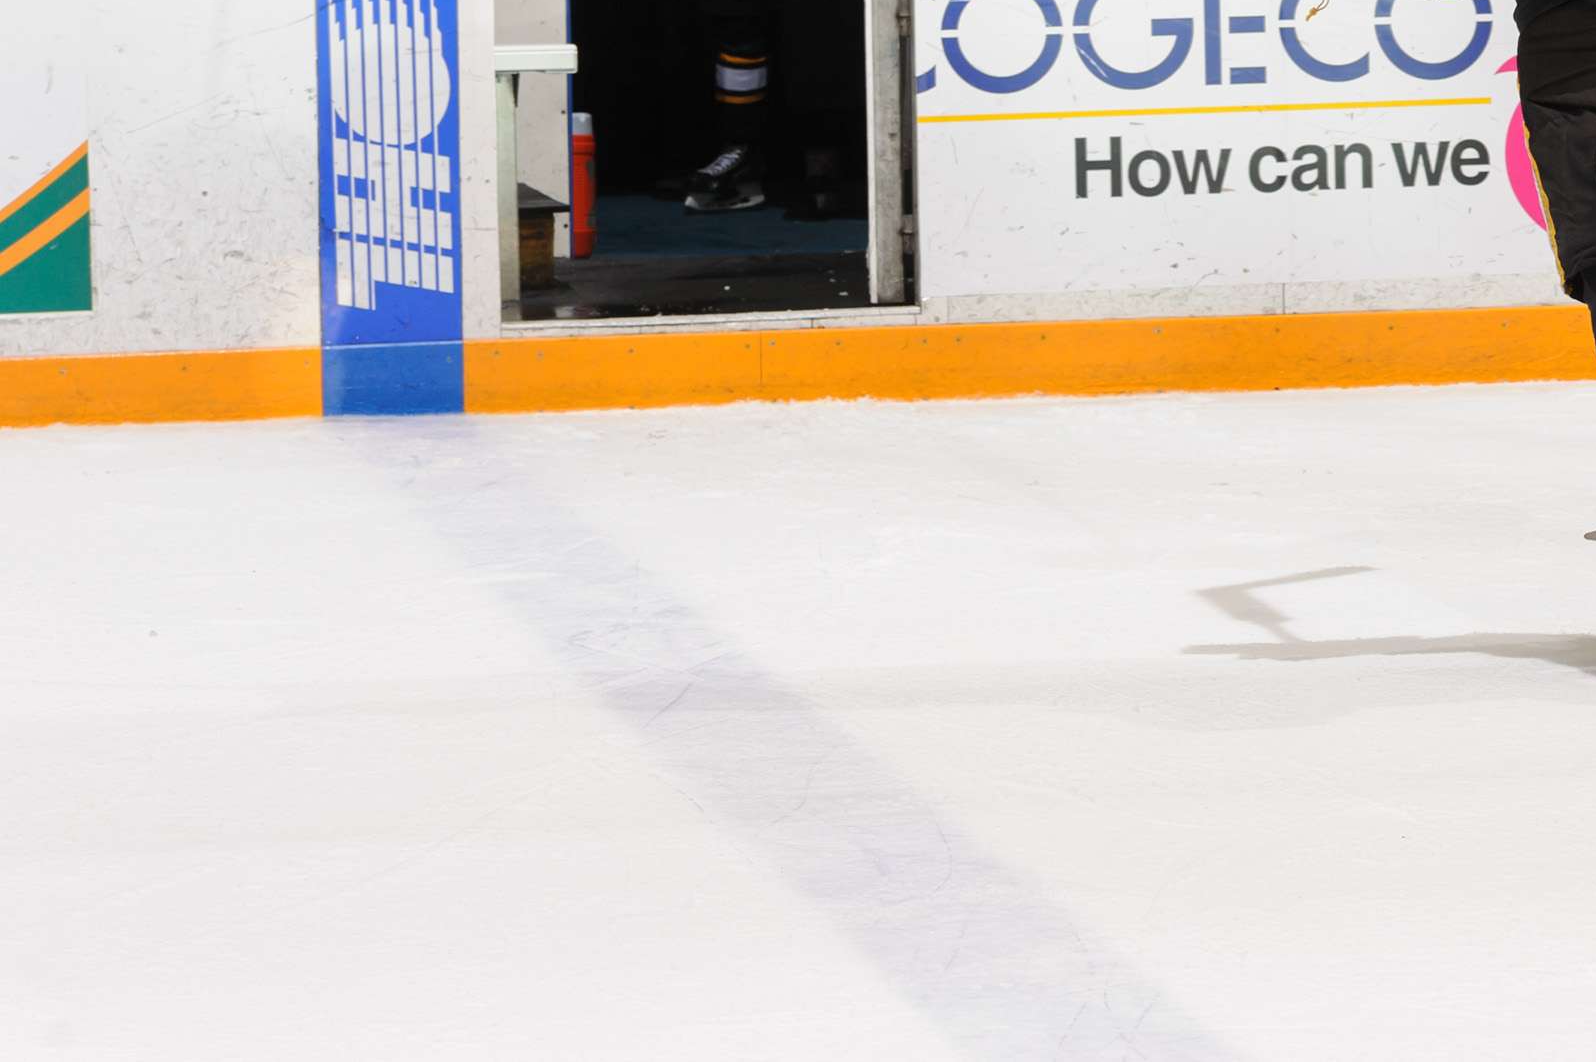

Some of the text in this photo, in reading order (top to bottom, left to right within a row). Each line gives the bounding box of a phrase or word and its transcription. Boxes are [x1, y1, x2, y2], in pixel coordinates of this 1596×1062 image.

[1074, 136, 1491, 199] How can we
